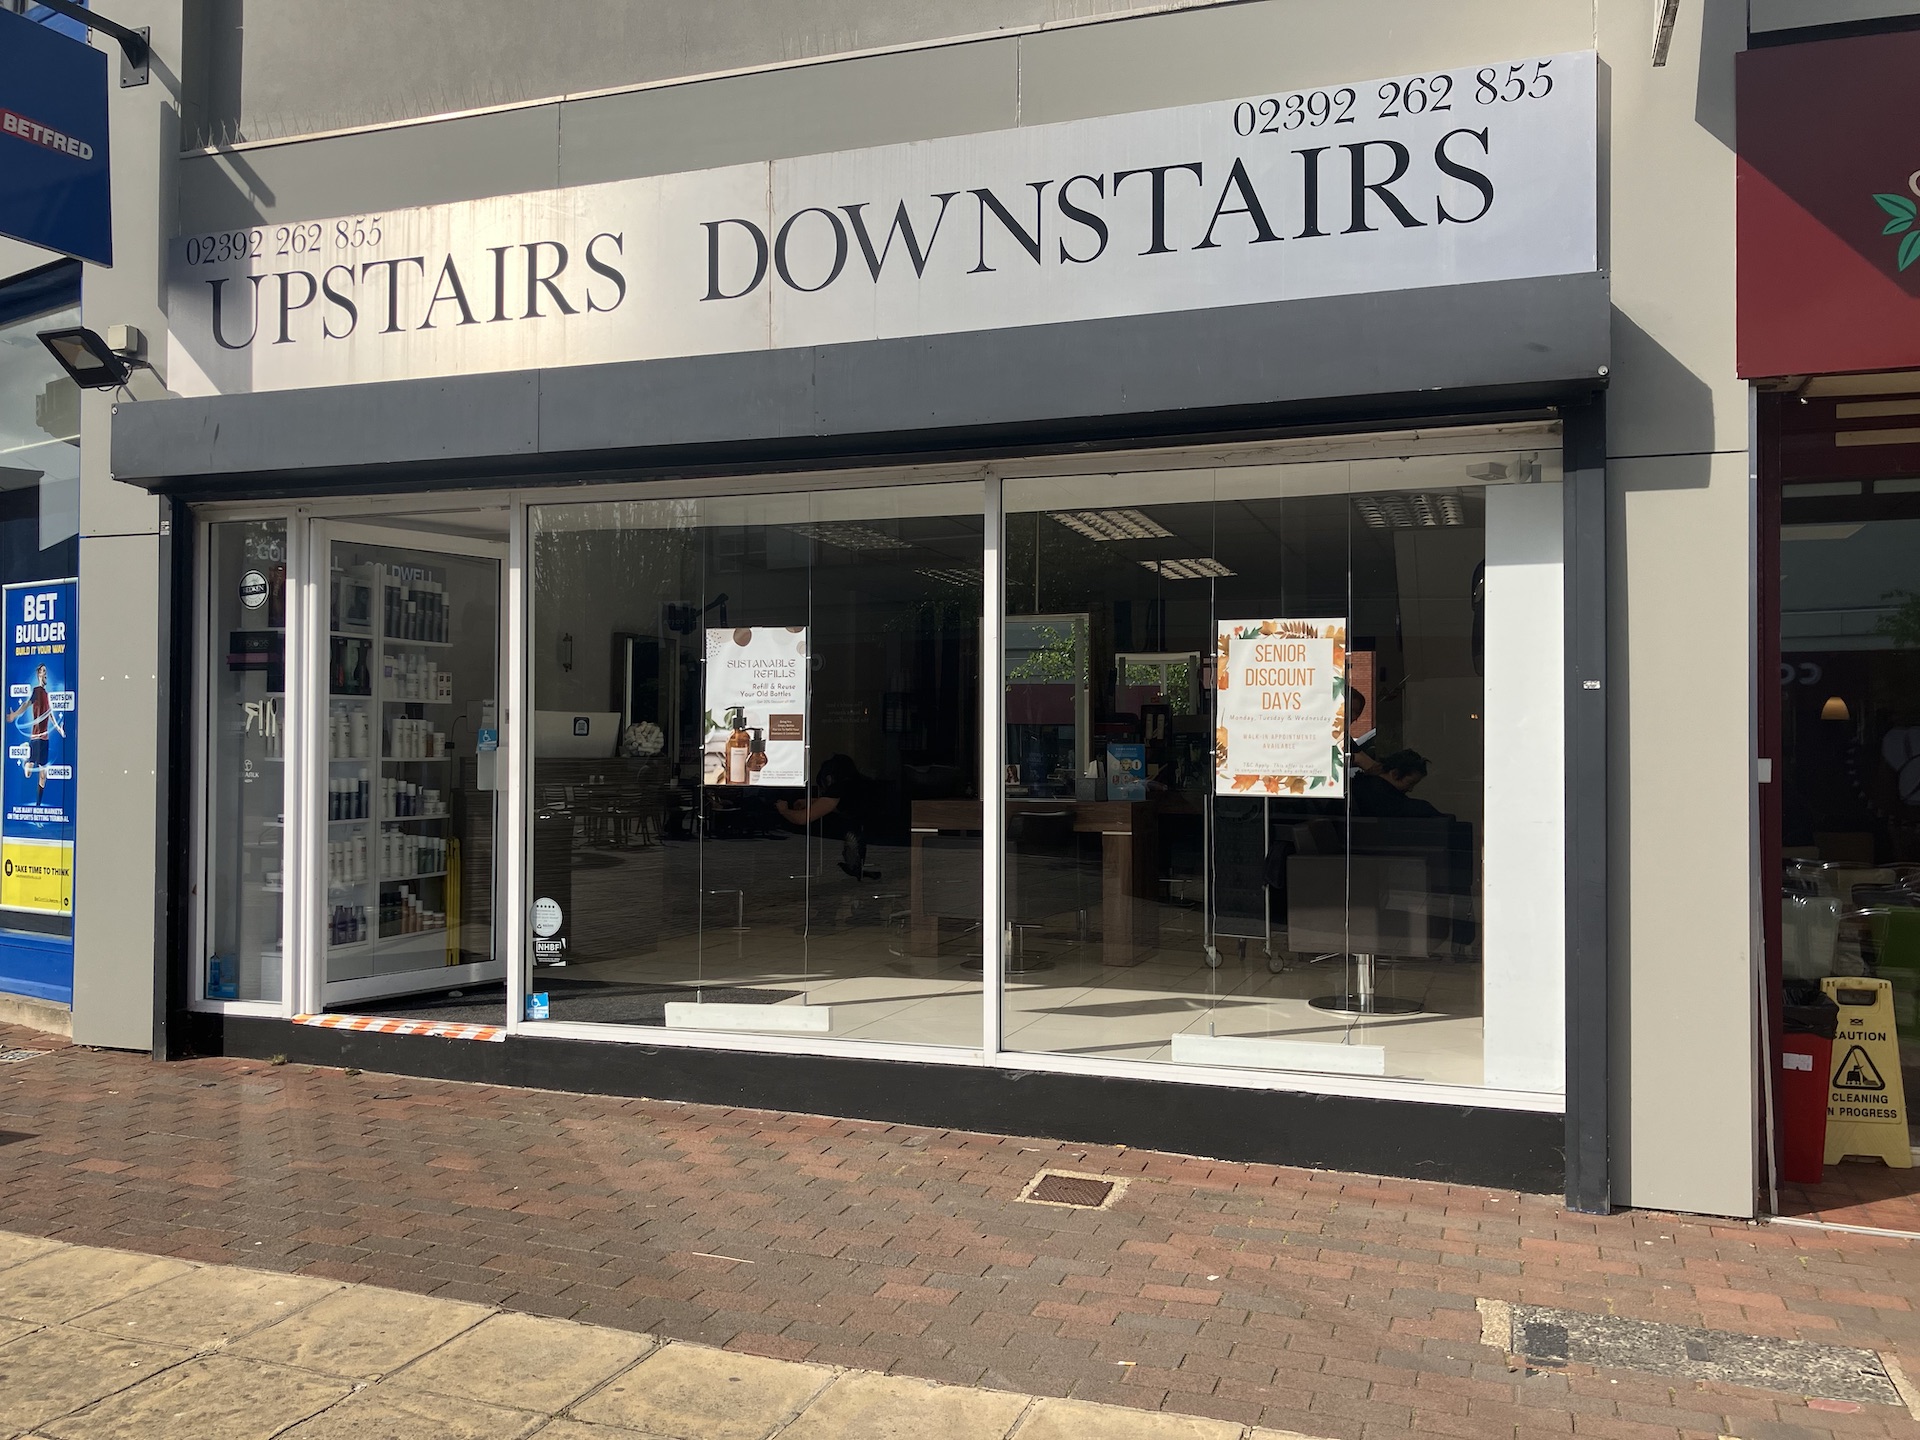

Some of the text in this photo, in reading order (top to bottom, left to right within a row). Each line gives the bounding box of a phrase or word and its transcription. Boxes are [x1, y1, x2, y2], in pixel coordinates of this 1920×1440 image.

[1233, 59, 1555, 137] 02392 262 855
[3, 112, 93, 160] BETFRED
[186, 216, 382, 266] 02392 262 855
[205, 127, 1496, 350] UPSTAIRS DOWNSTAIRS
[24, 592, 58, 622] BET
[16, 621, 66, 644] BUILDER
[15, 644, 66, 656] BUILD IT YOUR WAY
[1255, 644, 1306, 663] SENIOR
[727, 659, 796, 669] SUSTAINABLE
[753, 669, 796, 678] REFILLS
[1245, 668, 1316, 687] DISCOUNT
[13, 686, 28, 694] GOALS
[752, 682, 769, 690] Refill
[777, 682, 796, 690] Reuse
[740, 690, 755, 698] Your
[1262, 692, 1302, 710] DAYS
[1259, 714, 1285, 722] Tuesday
[1294, 714, 1331, 722] Wednesday
[11, 748, 28, 756] RESULT
[48, 768, 70, 776] CORNERS
[15, 864, 27, 873] TAKE
[28, 865, 42, 875] TIME
[43, 866, 51, 875] TO
[51, 867, 70, 877] THINK
[537, 943, 560, 951] NHBF
[1832, 1093, 1889, 1105] CLEANING
[1827, 1107, 1897, 1119] N PROGRESS
